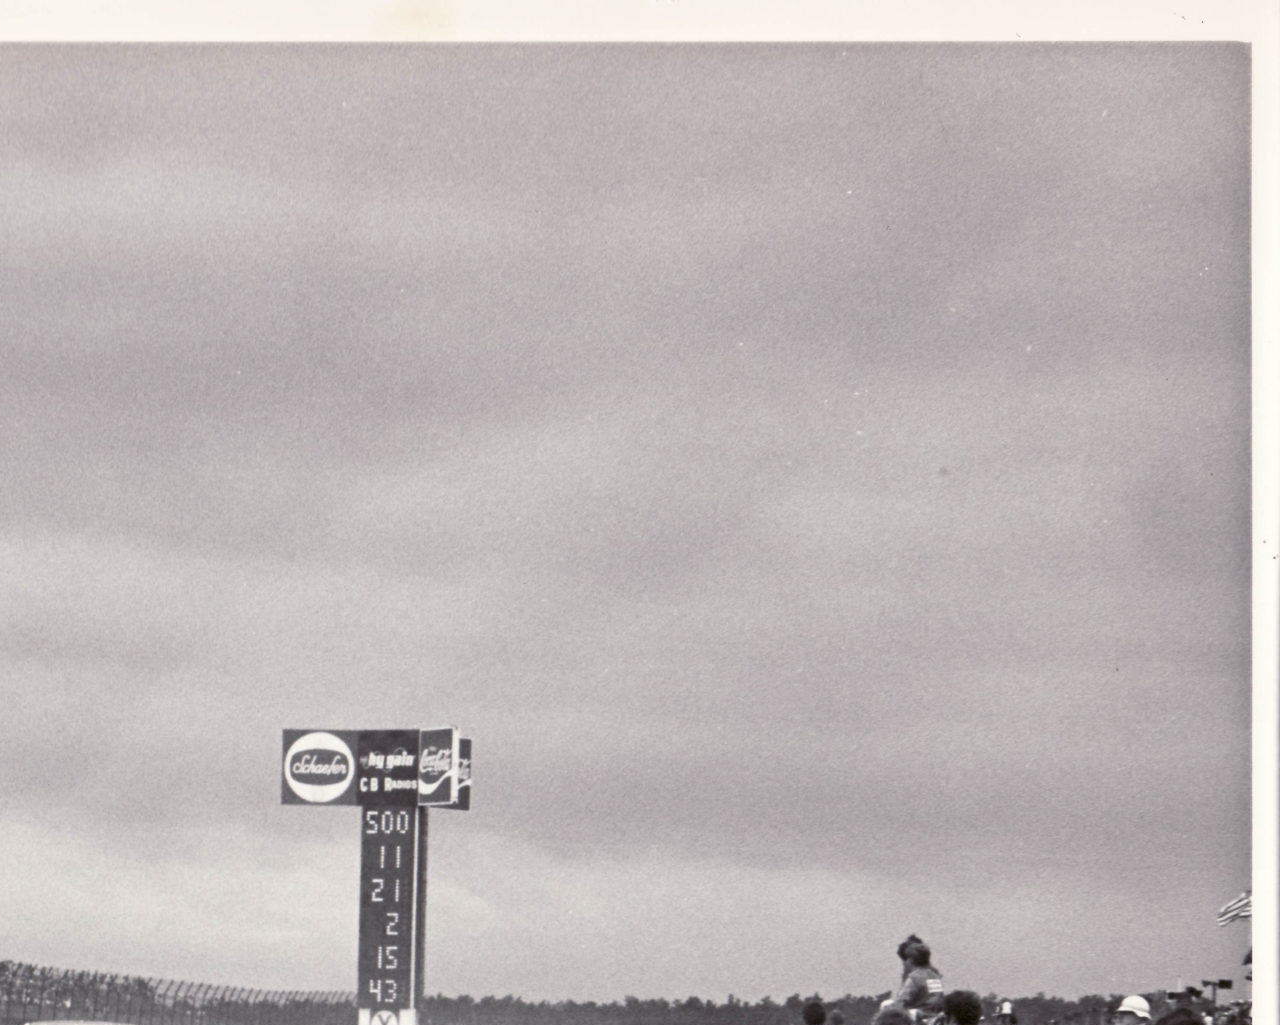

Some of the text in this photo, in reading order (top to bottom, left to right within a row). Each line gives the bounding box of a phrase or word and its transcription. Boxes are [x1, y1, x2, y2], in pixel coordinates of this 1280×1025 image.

[293, 754, 347, 775] Schaefer
[366, 811, 409, 834] 500
[380, 845, 401, 868] 11
[371, 879, 400, 902] 21
[386, 912, 399, 936] 2
[377, 946, 398, 969] 15
[369, 979, 397, 1003] 43
